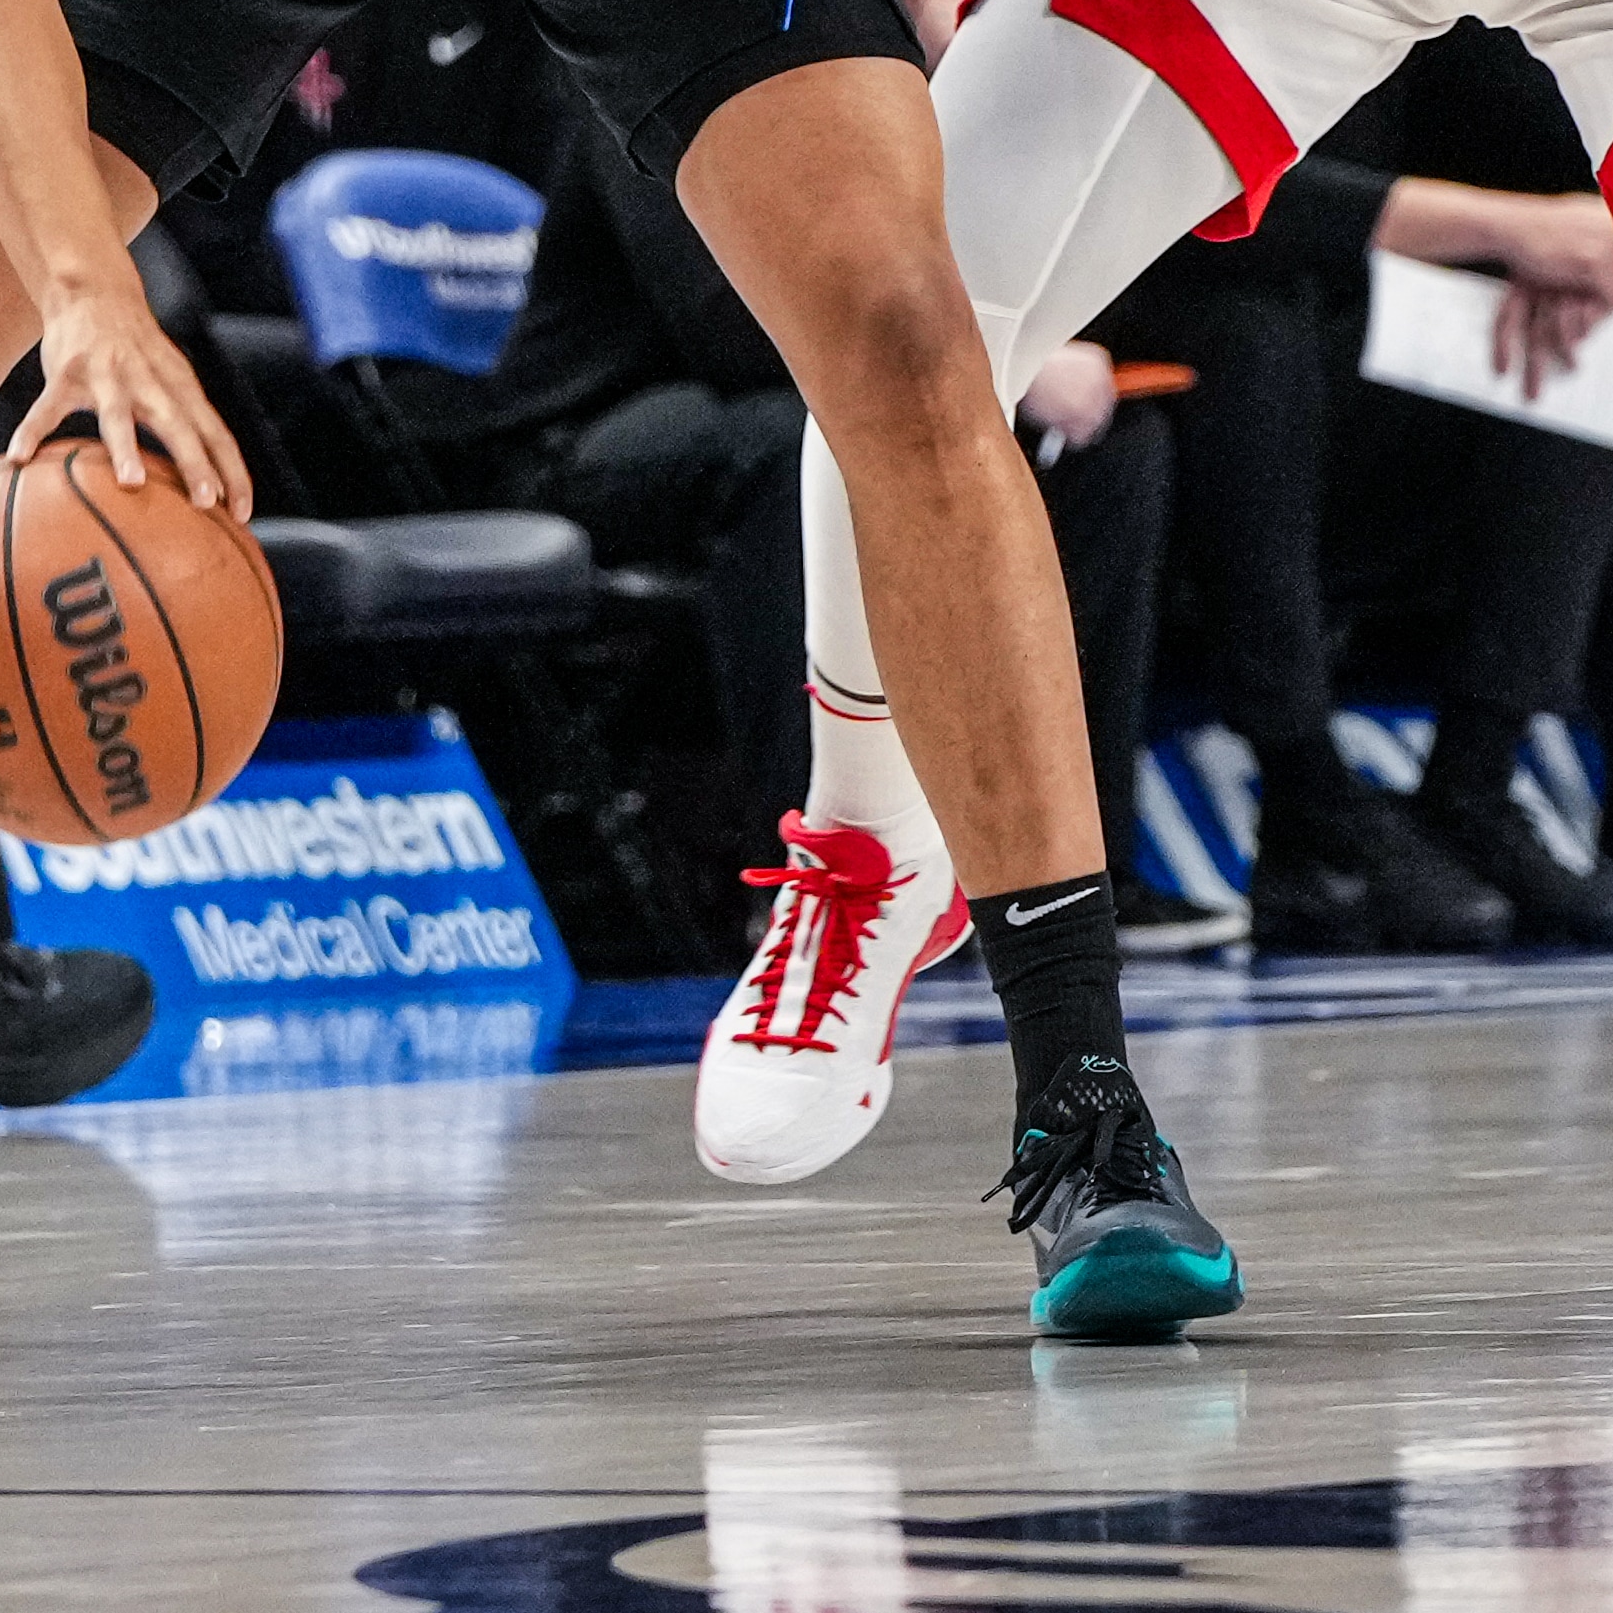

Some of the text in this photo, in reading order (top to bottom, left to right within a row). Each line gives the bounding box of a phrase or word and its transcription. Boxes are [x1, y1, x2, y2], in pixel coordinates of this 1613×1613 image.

[42, 556, 152, 818] Wilson
[172, 894, 543, 984] Medical Center
